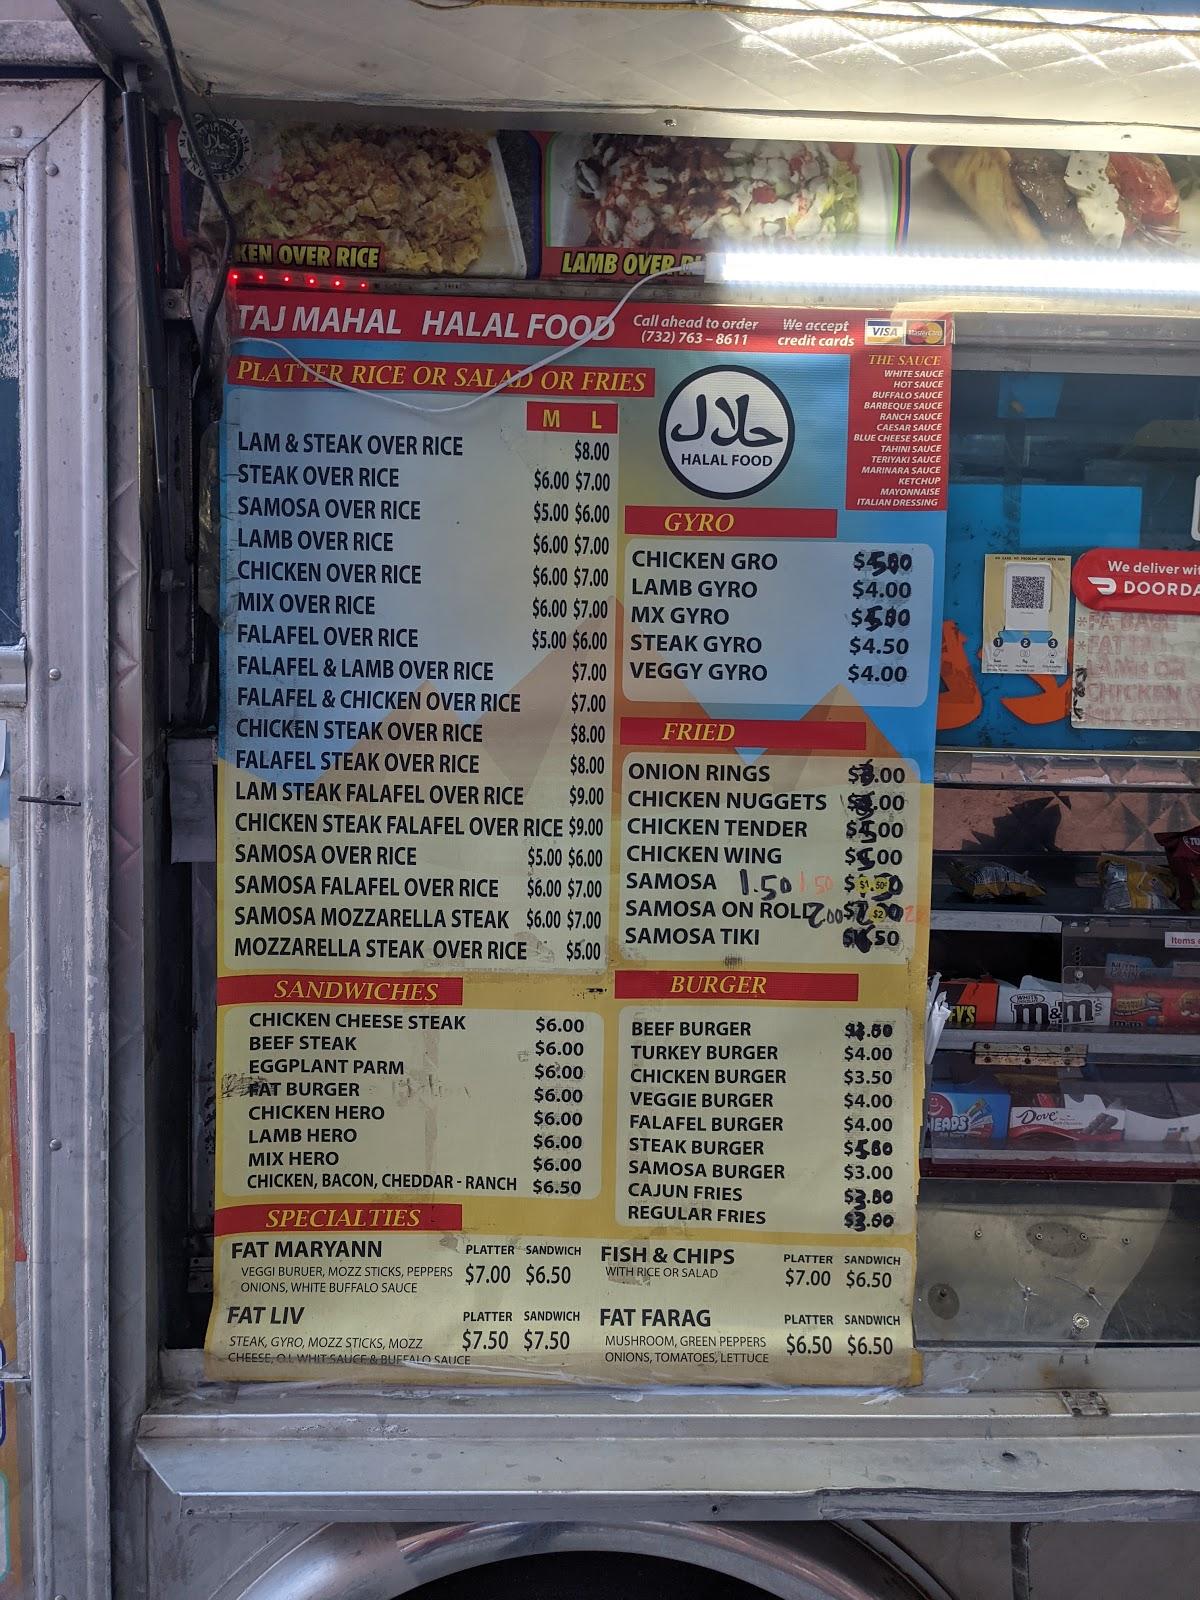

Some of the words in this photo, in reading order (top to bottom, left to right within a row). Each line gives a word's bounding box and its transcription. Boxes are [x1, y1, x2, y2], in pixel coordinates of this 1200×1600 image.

[278, 245, 330, 267] OVER
[336, 246, 379, 268] RICE
[561, 252, 620, 275] LAMB
[622, 252, 682, 276] OVER
[237, 305, 286, 332] TAJ
[292, 306, 401, 334] MAHAL
[422, 307, 520, 339] HALAL
[526, 312, 616, 342] FOOD
[633, 314, 658, 328] Call
[659, 316, 703, 329] ahead
[705, 319, 719, 330] to
[721, 319, 759, 331] order
[782, 319, 803, 331] We
[806, 320, 849, 334] accept
[641, 330, 676, 344] (732)
[678, 332, 702, 344] 763
[716, 334, 748, 346] 8611
[873, 327, 897, 336] VISA
[778, 334, 816, 346] credit
[818, 335, 855, 347] cards
[868, 355, 895, 365] THE
[898, 356, 942, 366] SAUCE
[236, 360, 344, 383] PLATTER
[351, 365, 407, 385] RICE
[412, 366, 447, 386] OR
[453, 368, 532, 389] SALAD
[540, 369, 573, 390] OR
[578, 372, 647, 393] FRIES
[884, 369, 914, 378] WHITE
[914, 369, 944, 378] SAUCE
[893, 380, 911, 389] HOT
[912, 380, 944, 389] SAUCE
[872, 391, 912, 399] BUFFALO
[912, 391, 943, 400] SAUCE
[864, 401, 912, 410] BARBEQUE
[912, 401, 943, 411] SAUCE
[542, 409, 560, 428] M
[591, 411, 602, 429] L
[879, 412, 912, 421] RANCH
[912, 412, 943, 421] SAUCE
[876, 423, 912, 431] CAESAR
[912, 423, 942, 432] SAUCE
[853, 433, 877, 442] BLUE
[878, 434, 910, 442] CHEESE
[912, 434, 942, 442] SAUCE
[238, 431, 281, 453] LAM
[285, 433, 298, 454] &
[303, 433, 363, 455] STEAK
[367, 435, 417, 456] OVER
[422, 436, 463, 457] RICE
[574, 441, 610, 462] $8.00
[881, 444, 912, 453] TAHINI
[912, 444, 942, 453] SAUCE
[681, 454, 728, 466] HALAL
[731, 454, 773, 467] FOOD
[871, 455, 911, 464] TERIYAKI
[912, 455, 941, 464] SAUCE
[861, 466, 910, 474] MARINARA
[911, 466, 941, 475] SAUCE
[898, 477, 941, 485] KETCHUP
[880, 487, 940, 496] MAYONNAISE
[856, 498, 891, 507] ITALIAN
[891, 498, 938, 507] DRESSING
[663, 512, 735, 533] GYRO
[631, 550, 725, 570] CHICKEN
[731, 552, 778, 571] GRO
[1108, 560, 1131, 572] We
[1133, 562, 1181, 574] deliver
[631, 578, 692, 597] LAMB
[697, 580, 758, 599] GYRO
[852, 580, 912, 600] $4.00
[1023, 639, 1029, 647] 2
[1050, 639, 1056, 647] 3
[630, 662, 702, 680] VEGGY
[708, 663, 768, 682] GYRO
[848, 665, 907, 683] $4.00
[662, 722, 736, 742] FRIED
[628, 763, 700, 781] ONION
[706, 764, 770, 782] RINGS
[626, 872, 717, 890] SAMOSA
[273, 980, 439, 1001] SANDWICHES
[670, 975, 768, 994] BURGER
[249, 1012, 331, 1028] CHICKEN
[335, 1013, 403, 1029] CHEESE
[407, 1015, 466, 1030] STEAK
[535, 1017, 585, 1034] $6.00
[631, 1045, 703, 1061] TURKEY
[706, 1046, 778, 1061] BURGER
[844, 1047, 893, 1062] $4.00
[247, 1173, 318, 1190] CHICKEN,
[321, 1174, 378, 1190] BACON,
[381, 1174, 454, 1189] CHEDDAR
[465, 1176, 518, 1192] RANCH
[533, 1180, 582, 1196] $6.50
[628, 1182, 689, 1199] CAJUN
[693, 1185, 743, 1201] FRIES
[265, 1209, 421, 1228] SPECIALTIES
[231, 1242, 269, 1259] FAT
[273, 1240, 383, 1258] MARYANN
[465, 1244, 515, 1256] PLATTER
[525, 1245, 582, 1257] SANDWICH
[600, 1246, 647, 1263] FISH
[652, 1247, 668, 1263] &
[673, 1247, 735, 1265] CHIPS
[783, 1254, 833, 1264] PLATTER
[844, 1255, 901, 1266] SANDWICH
[241, 1266, 276, 1278] VEGGI
[278, 1267, 326, 1279] BURUER,
[328, 1266, 362, 1278] MOZZ
[364, 1266, 405, 1279] STICKS,
[407, 1266, 453, 1278] PEPPERS
[465, 1264, 511, 1284] $7.00
[525, 1265, 572, 1285] $6.50
[606, 1267, 635, 1278] WITH
[636, 1267, 661, 1278] RICE
[663, 1267, 679, 1278] OR
[681, 1268, 719, 1279] SALAD
[785, 1268, 831, 1287] $7.00
[846, 1271, 892, 1289] $6.50
[240, 1282, 289, 1295] ONIONS,
[290, 1282, 326, 1293] WHITE
[329, 1282, 378, 1293] BUFFALO
[381, 1282, 418, 1294] SAUCE
[226, 1306, 267, 1325] FAT
[270, 1307, 305, 1325] LIV
[600, 1308, 636, 1327] FAT
[641, 1309, 711, 1327] FARAG
[229, 1336, 268, 1350] STEAK,
[271, 1337, 305, 1350] GYRO,
[308, 1337, 343, 1349] MOZZ
[345, 1337, 386, 1350] STICKS,
[388, 1338, 423, 1349] MOZZ
[605, 1335, 678, 1348] MUSHROOM,
[680, 1336, 717, 1348] GREEN
[719, 1336, 767, 1348] PEPPERS
[786, 1335, 833, 1355] $6.50
[847, 1336, 893, 1356] $6.50
[605, 1352, 653, 1365] ONIONS,
[720, 1352, 769, 1363] LETTUCE
